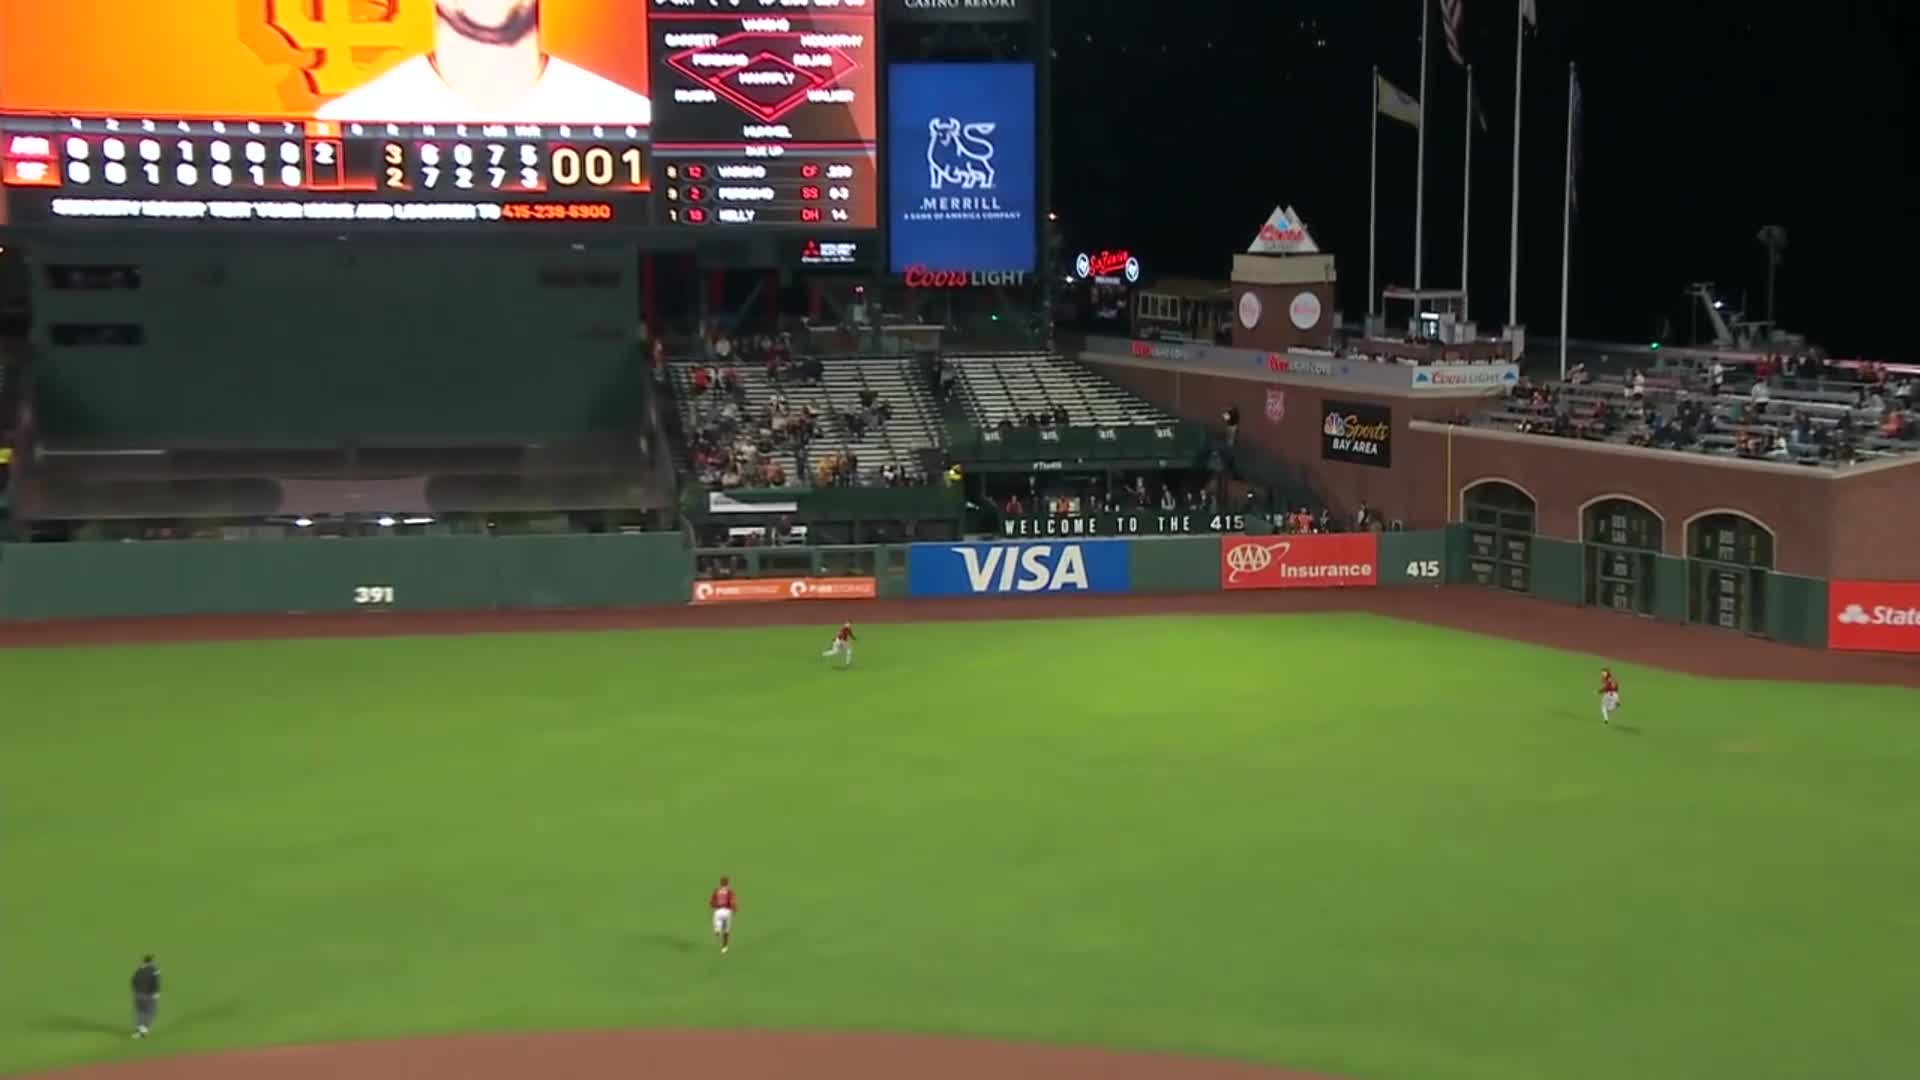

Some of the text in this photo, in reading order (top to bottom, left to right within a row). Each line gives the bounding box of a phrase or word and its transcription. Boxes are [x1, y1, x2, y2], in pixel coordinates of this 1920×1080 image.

[177, 141, 192, 161] 1
[315, 143, 333, 164] 2
[385, 144, 402, 164] 3
[488, 144, 504, 165] 7
[143, 164, 159, 184] 1
[249, 165, 264, 185] 1
[386, 168, 403, 187] 2
[423, 167, 439, 188] 7
[456, 168, 473, 188] 2
[488, 168, 505, 188] 7
[520, 168, 538, 188] 3
[904, 262, 1025, 287] Coors LIGHT
[1469, 373, 1500, 384] LIGHT
[1343, 414, 1390, 441] Sports
[1332, 438, 1379, 455] BAY AREA
[1004, 515, 1245, 536] WELCOME TO THE 415
[951, 544, 1089, 592] VISA
[1229, 546, 1372, 579] AAA Insurance
[1406, 560, 1440, 577] 415
[353, 586, 394, 603] 391
